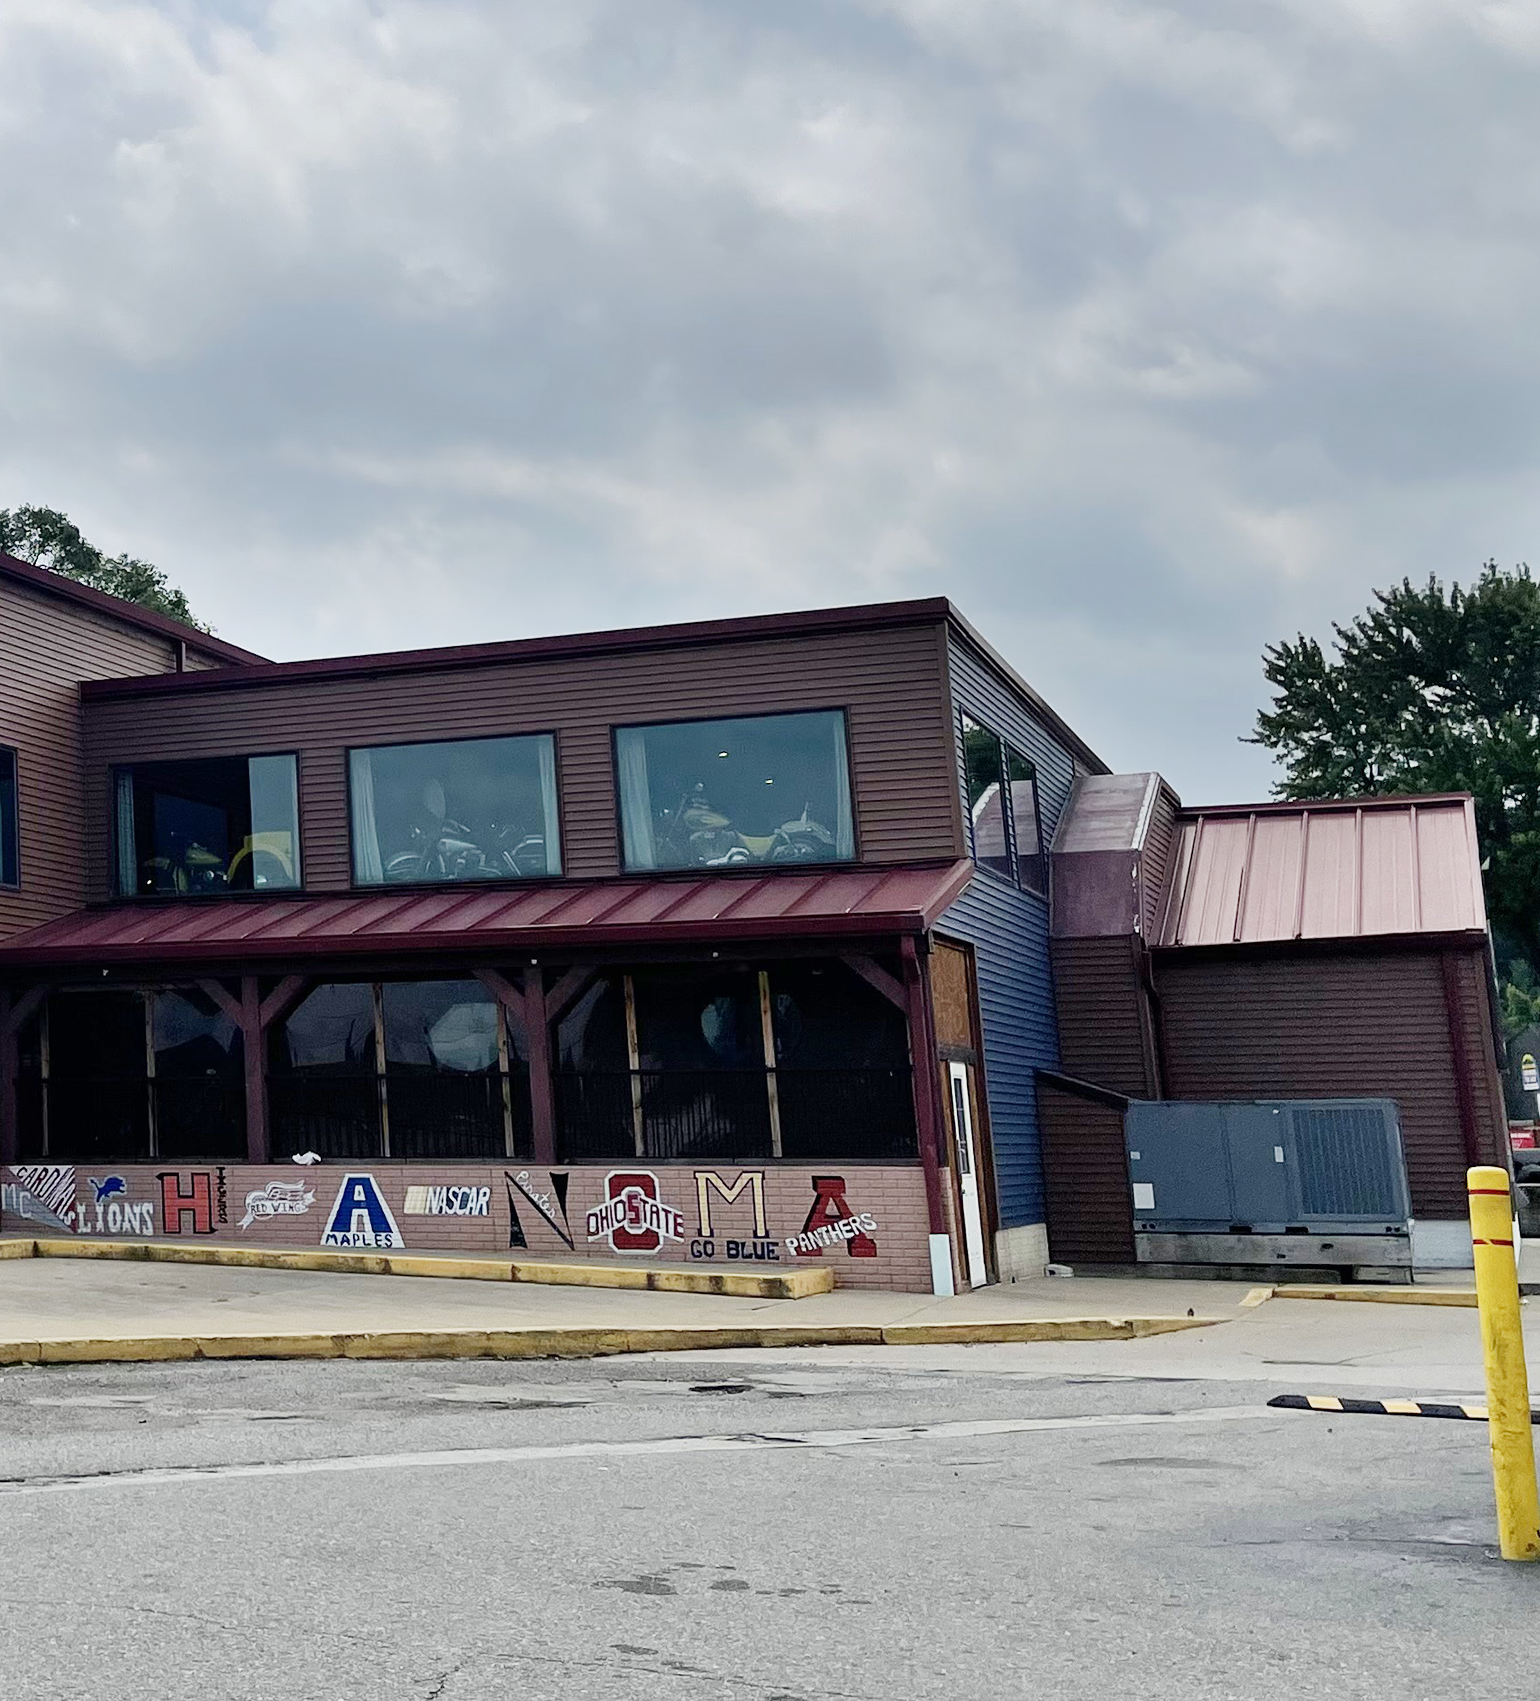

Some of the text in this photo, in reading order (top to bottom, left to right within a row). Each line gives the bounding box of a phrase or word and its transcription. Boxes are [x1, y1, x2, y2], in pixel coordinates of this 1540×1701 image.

[76, 1202, 154, 1236] LIONS
[156, 1172, 219, 1235] H
[250, 1200, 309, 1214] RED WINGS
[329, 1176, 394, 1234] A
[426, 1186, 491, 1216] NASCAR
[586, 1193, 685, 1237] OHIO STATE
[693, 1170, 770, 1239] M
[797, 1175, 877, 1257] A
[325, 1233, 393, 1248] MAPLES
[691, 1239, 780, 1261] GO BLUE
[784, 1212, 878, 1256] PANTHERS
